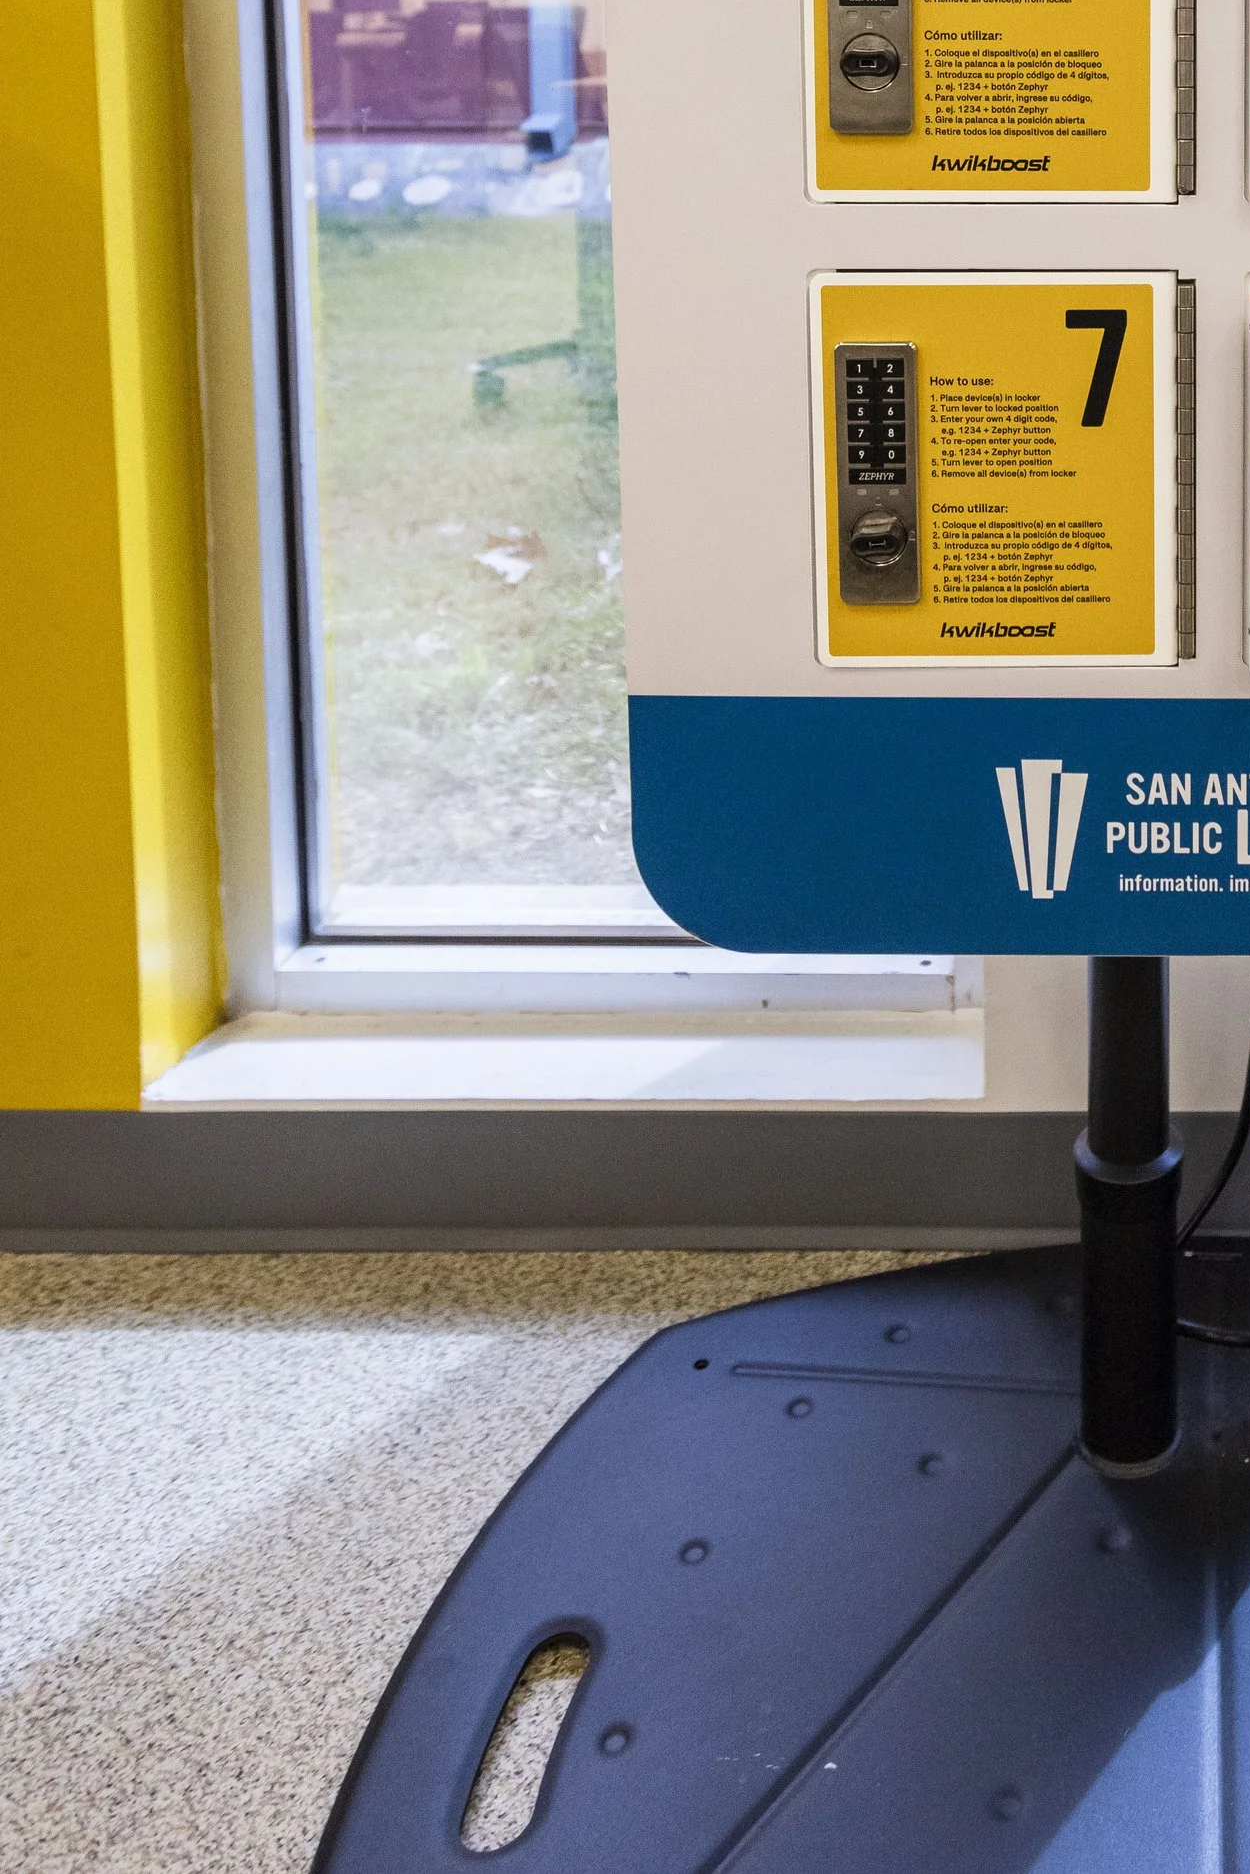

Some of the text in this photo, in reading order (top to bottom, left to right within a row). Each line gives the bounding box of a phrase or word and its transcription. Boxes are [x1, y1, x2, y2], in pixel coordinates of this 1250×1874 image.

[923, 29, 1003, 41] Cómo utilizar:
[931, 154, 1051, 172] kwikboost
[1065, 309, 1128, 428] 7
[929, 376, 994, 387] How to use:
[858, 471, 895, 481] ZEPHYR
[931, 503, 1008, 514] Cómo utilizar:
[933, 594, 1111, 605] 6. Retire todos los dispositivos del casillero
[940, 621, 1057, 638] kwikboost
[1125, 772, 1192, 806] SAN
[1105, 821, 1223, 855] PUBLIC
[1118, 874, 1224, 894] information.
